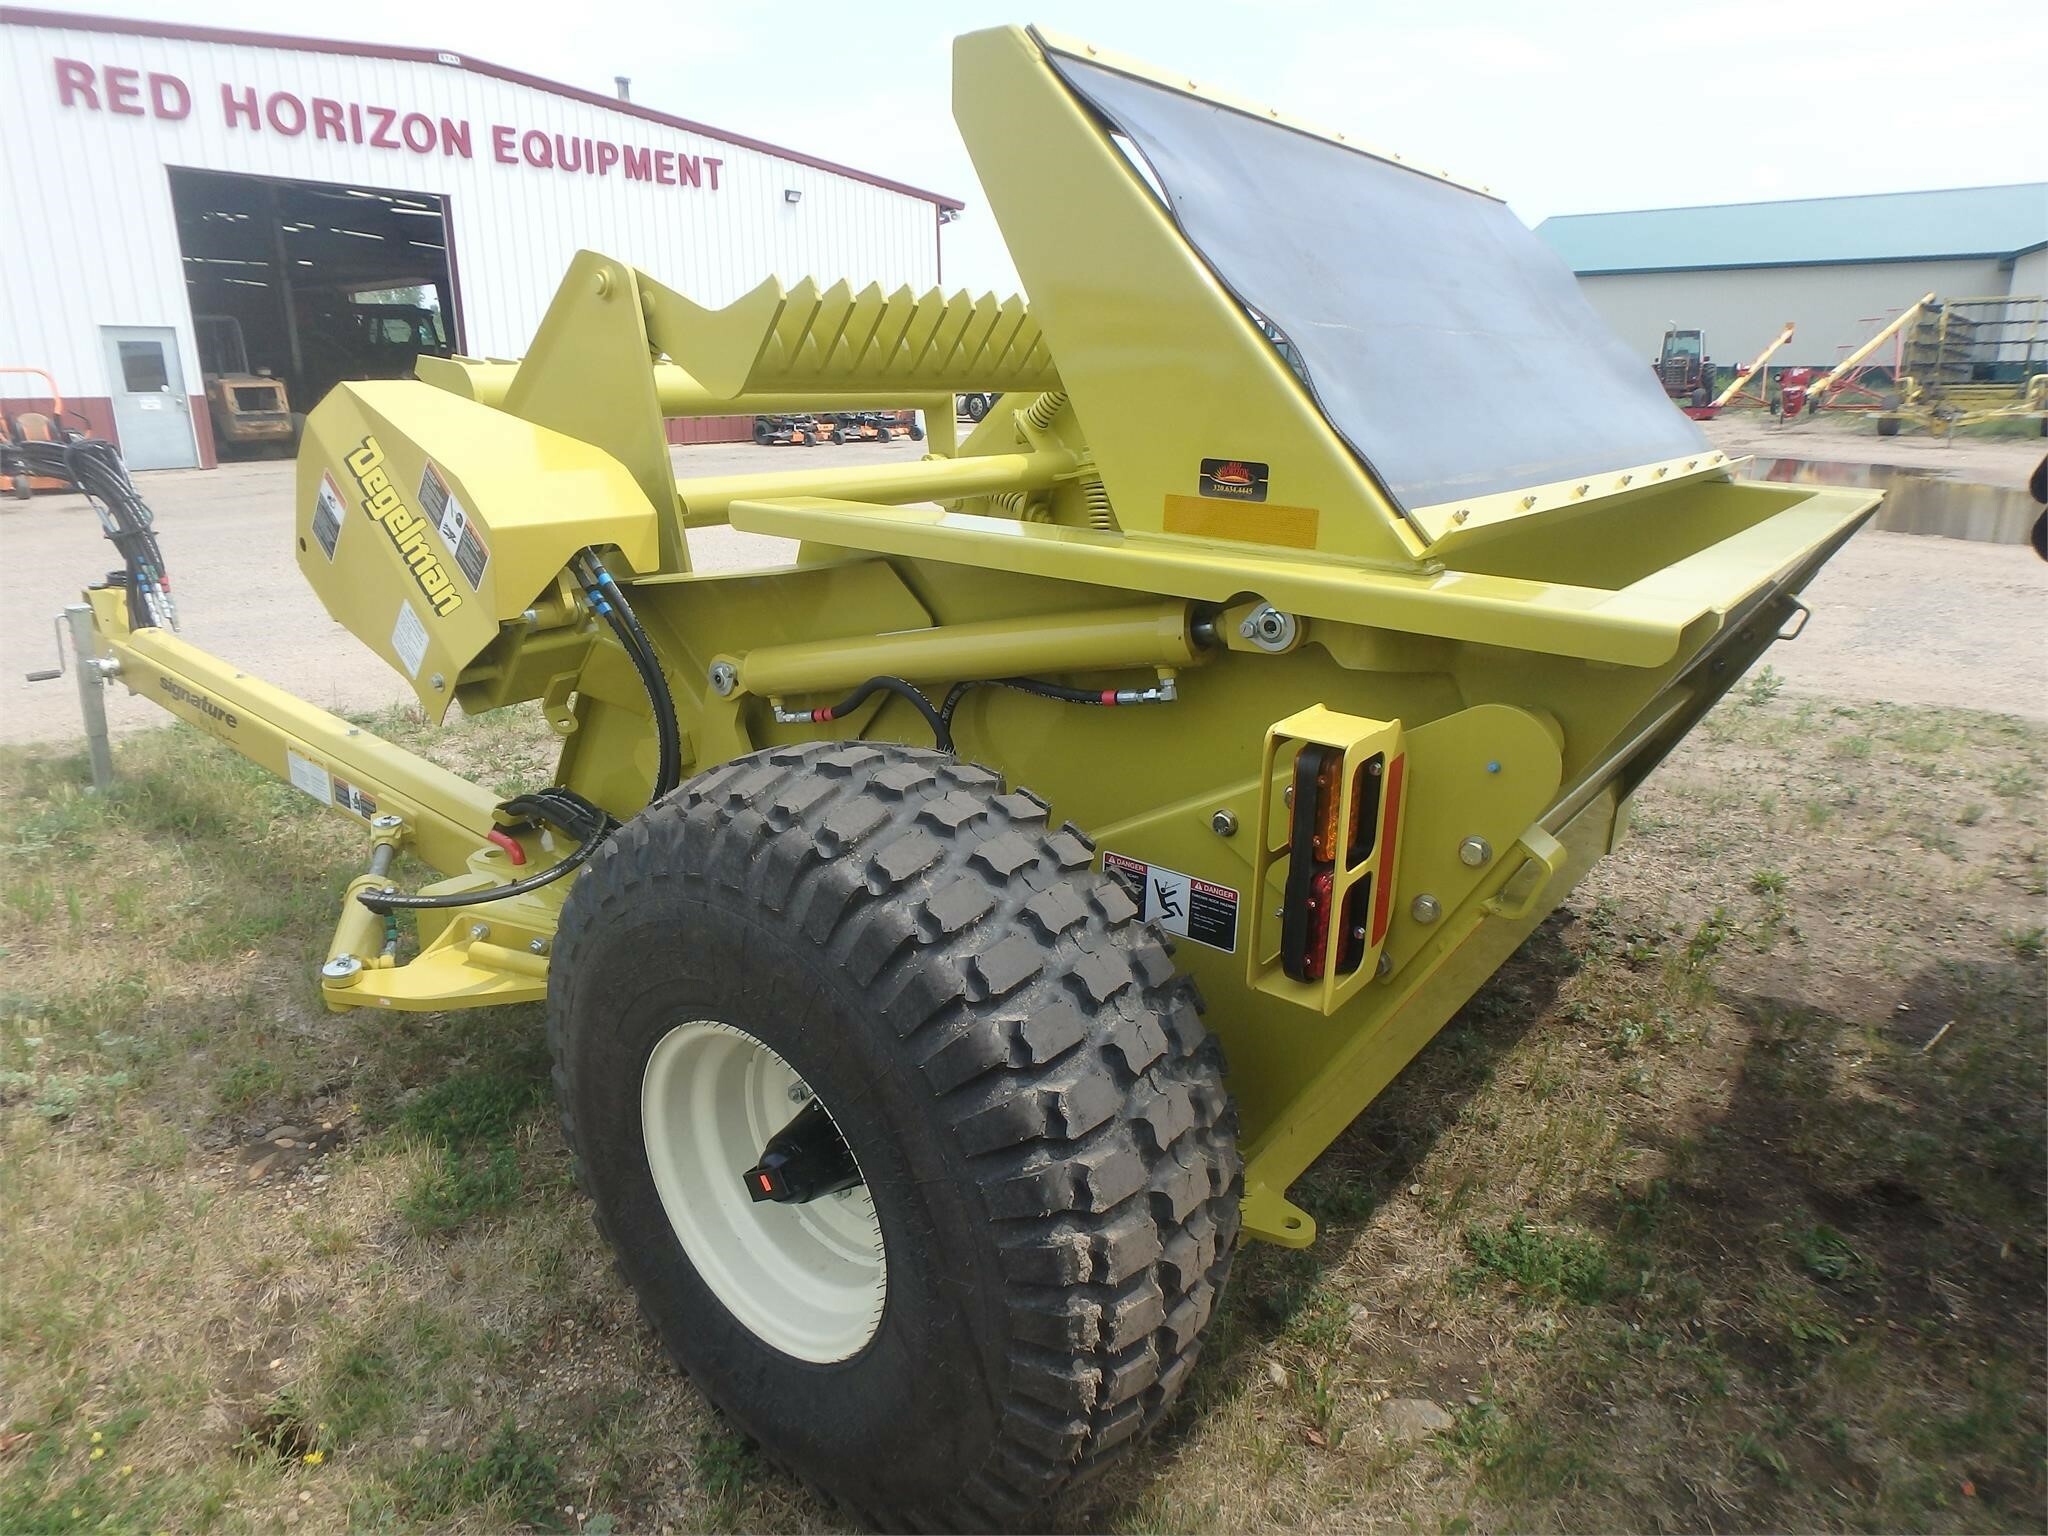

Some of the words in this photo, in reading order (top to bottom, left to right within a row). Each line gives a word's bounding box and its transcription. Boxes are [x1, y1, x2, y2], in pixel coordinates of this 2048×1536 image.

[53, 57, 191, 120] RED
[221, 83, 472, 158] HORIZON
[492, 124, 723, 190] EQUIPMENT
[344, 435, 463, 617] Degelman
[160, 676, 238, 729] signature
[1116, 858, 1145, 872] DANGER
[1203, 883, 1234, 900] DANGER
